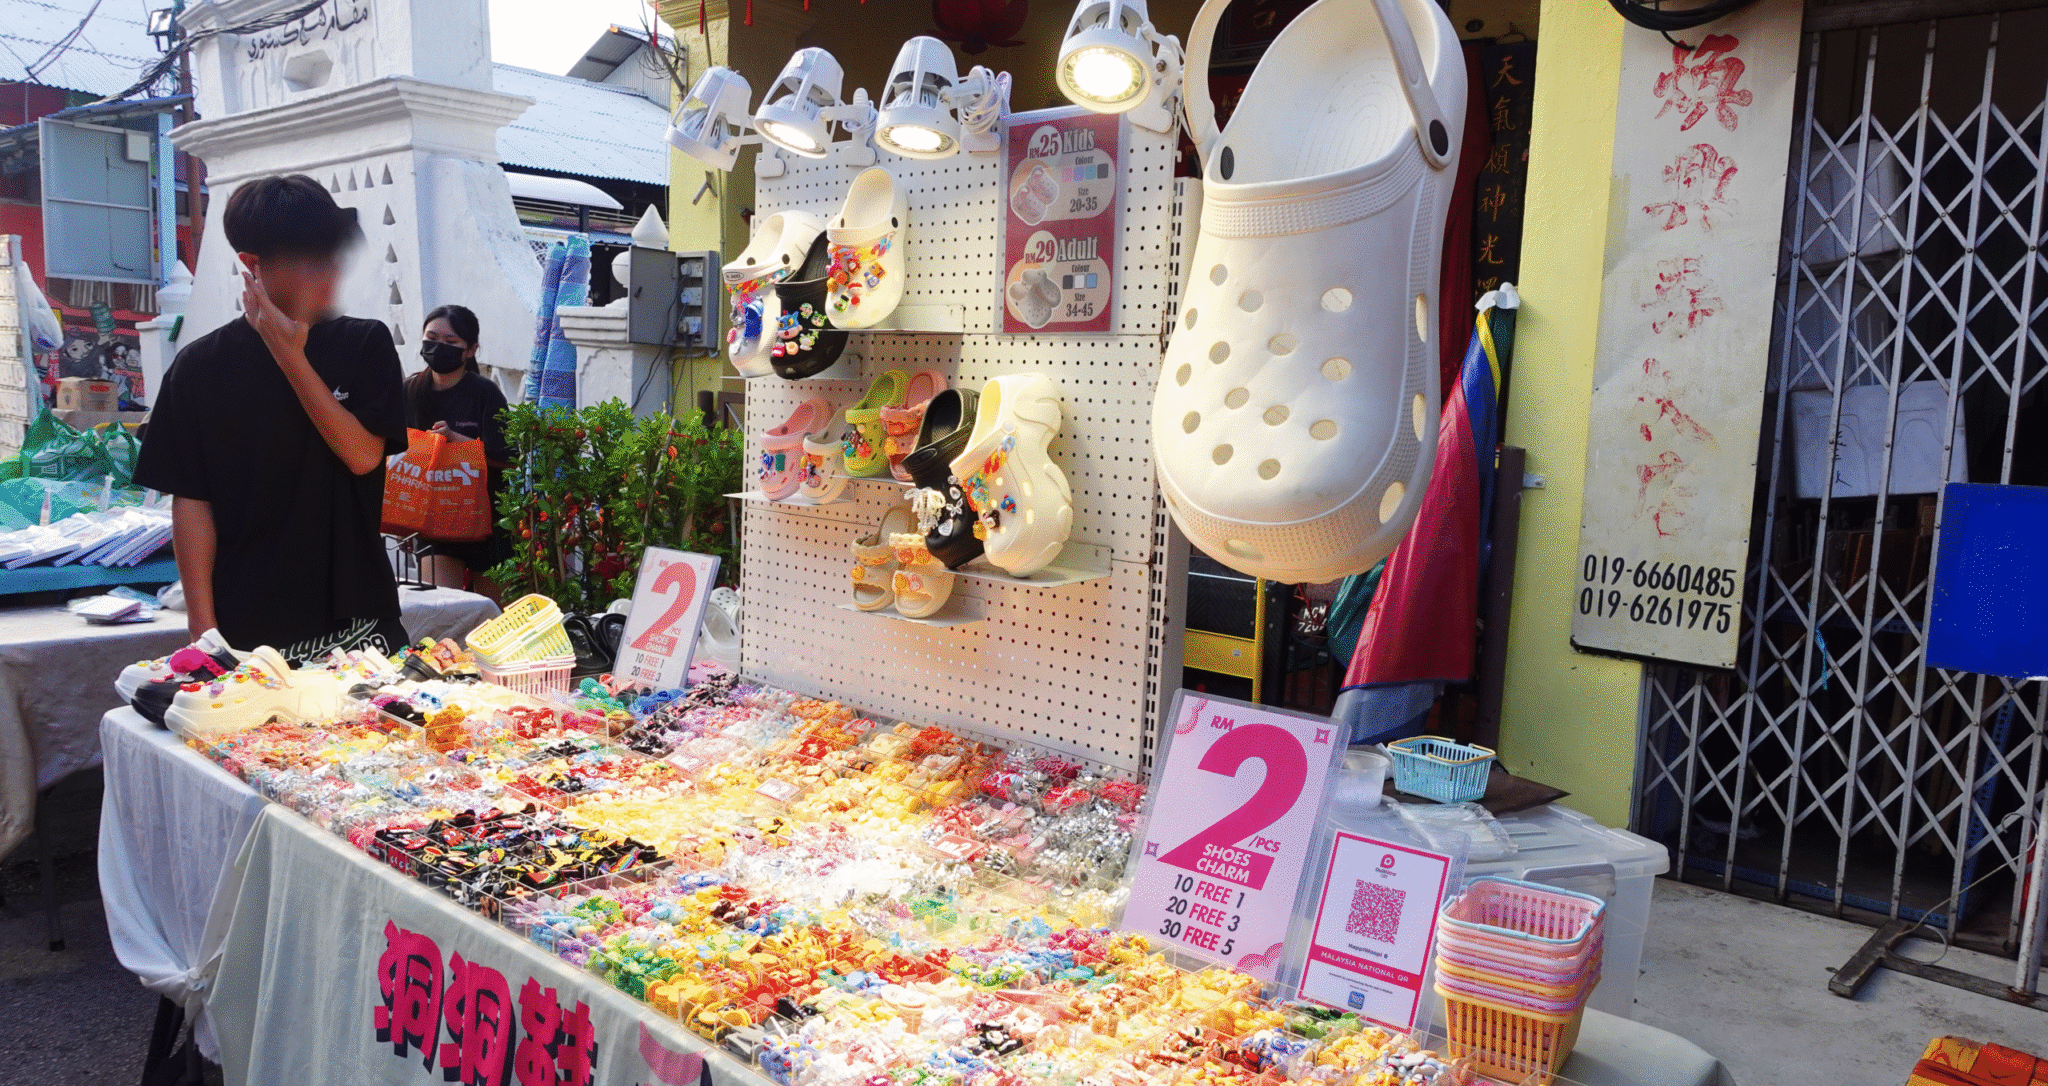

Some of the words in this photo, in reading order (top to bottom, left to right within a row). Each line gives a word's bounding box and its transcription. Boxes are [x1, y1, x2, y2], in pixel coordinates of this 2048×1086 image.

[1062, 128, 1096, 154] Kids
[1075, 156, 1094, 166] Colour
[1070, 196, 1098, 213] 20-35
[1077, 187, 1090, 196] Size
[1057, 235, 1099, 262] Adult
[1071, 264, 1090, 273] Colour
[1066, 302, 1094, 317] 34-45
[1074, 293, 1086, 302] Size
[1583, 554, 1738, 599] 019-6660485
[629, 561, 697, 658] 2
[1580, 587, 1733, 634] 019-6261975
[631, 665, 641, 677] 20
[640, 668, 656, 681] FREE
[655, 672, 662, 682] 3
[635, 652, 645, 664] 10
[644, 655, 660, 668] FREE
[660, 658, 665, 669] 1
[1210, 715, 1235, 731] RM
[1156, 723, 1308, 891] 2
[1202, 842, 1252, 868] SHOES
[1195, 856, 1251, 884] CHARM
[1173, 874, 1194, 894] 10
[1194, 880, 1233, 905] FREE
[1235, 892, 1246, 909] 1
[1165, 896, 1188, 916] 20
[1188, 902, 1227, 928] FREE
[1227, 915, 1241, 932] 3
[1159, 918, 1182, 939] 30
[1182, 925, 1222, 951] FREE
[1220, 938, 1236, 956] 5
[1320, 950, 1357, 967] MALAYSIA
[1358, 962, 1395, 979] NATIONAL
[1397, 974, 1409, 983] QR
[373, 918, 599, 1086] 洞洞鞋
